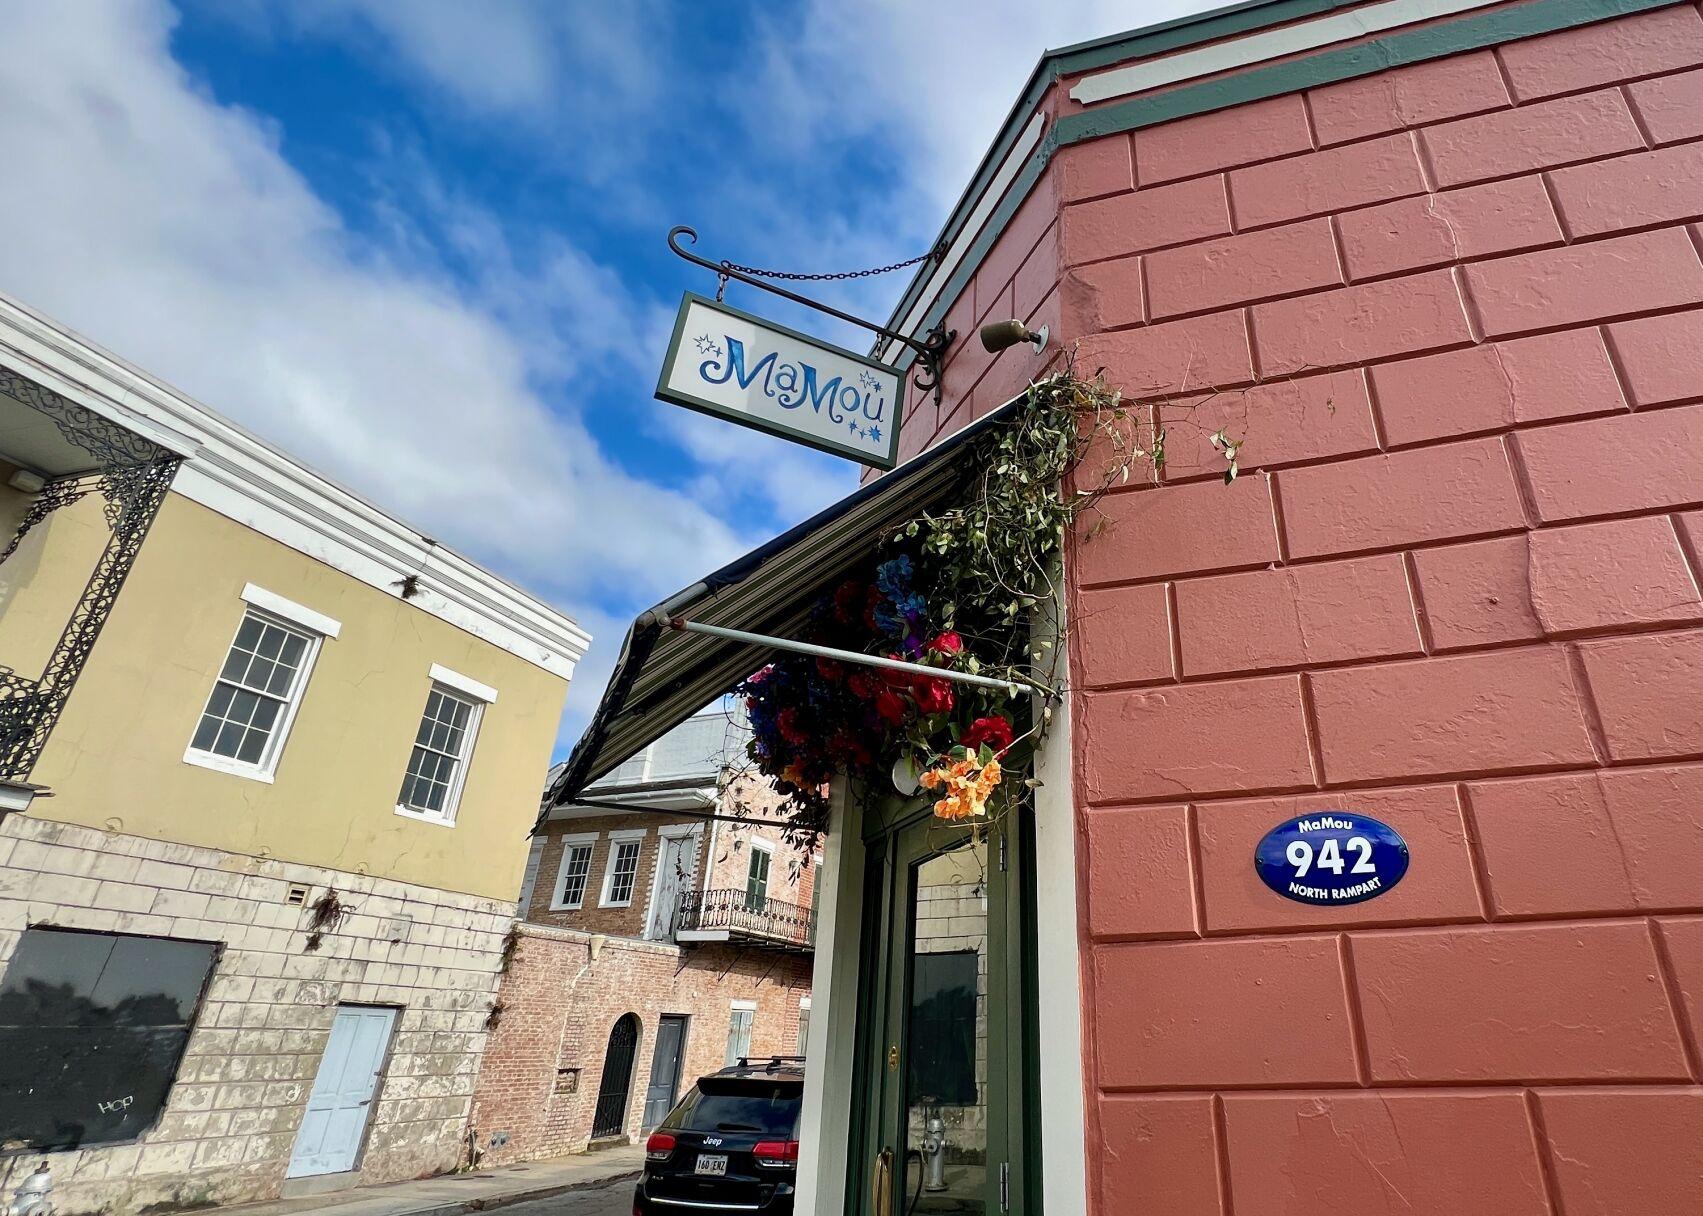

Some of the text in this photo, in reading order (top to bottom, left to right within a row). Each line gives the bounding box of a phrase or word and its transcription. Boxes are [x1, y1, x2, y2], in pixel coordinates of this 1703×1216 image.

[699, 334, 884, 425] MaMou
[1298, 816, 1353, 834] MaMou
[1285, 836, 1376, 878] 942
[1288, 876, 1382, 899] NORTH RAMPART
[702, 1135, 723, 1147] Jeep
